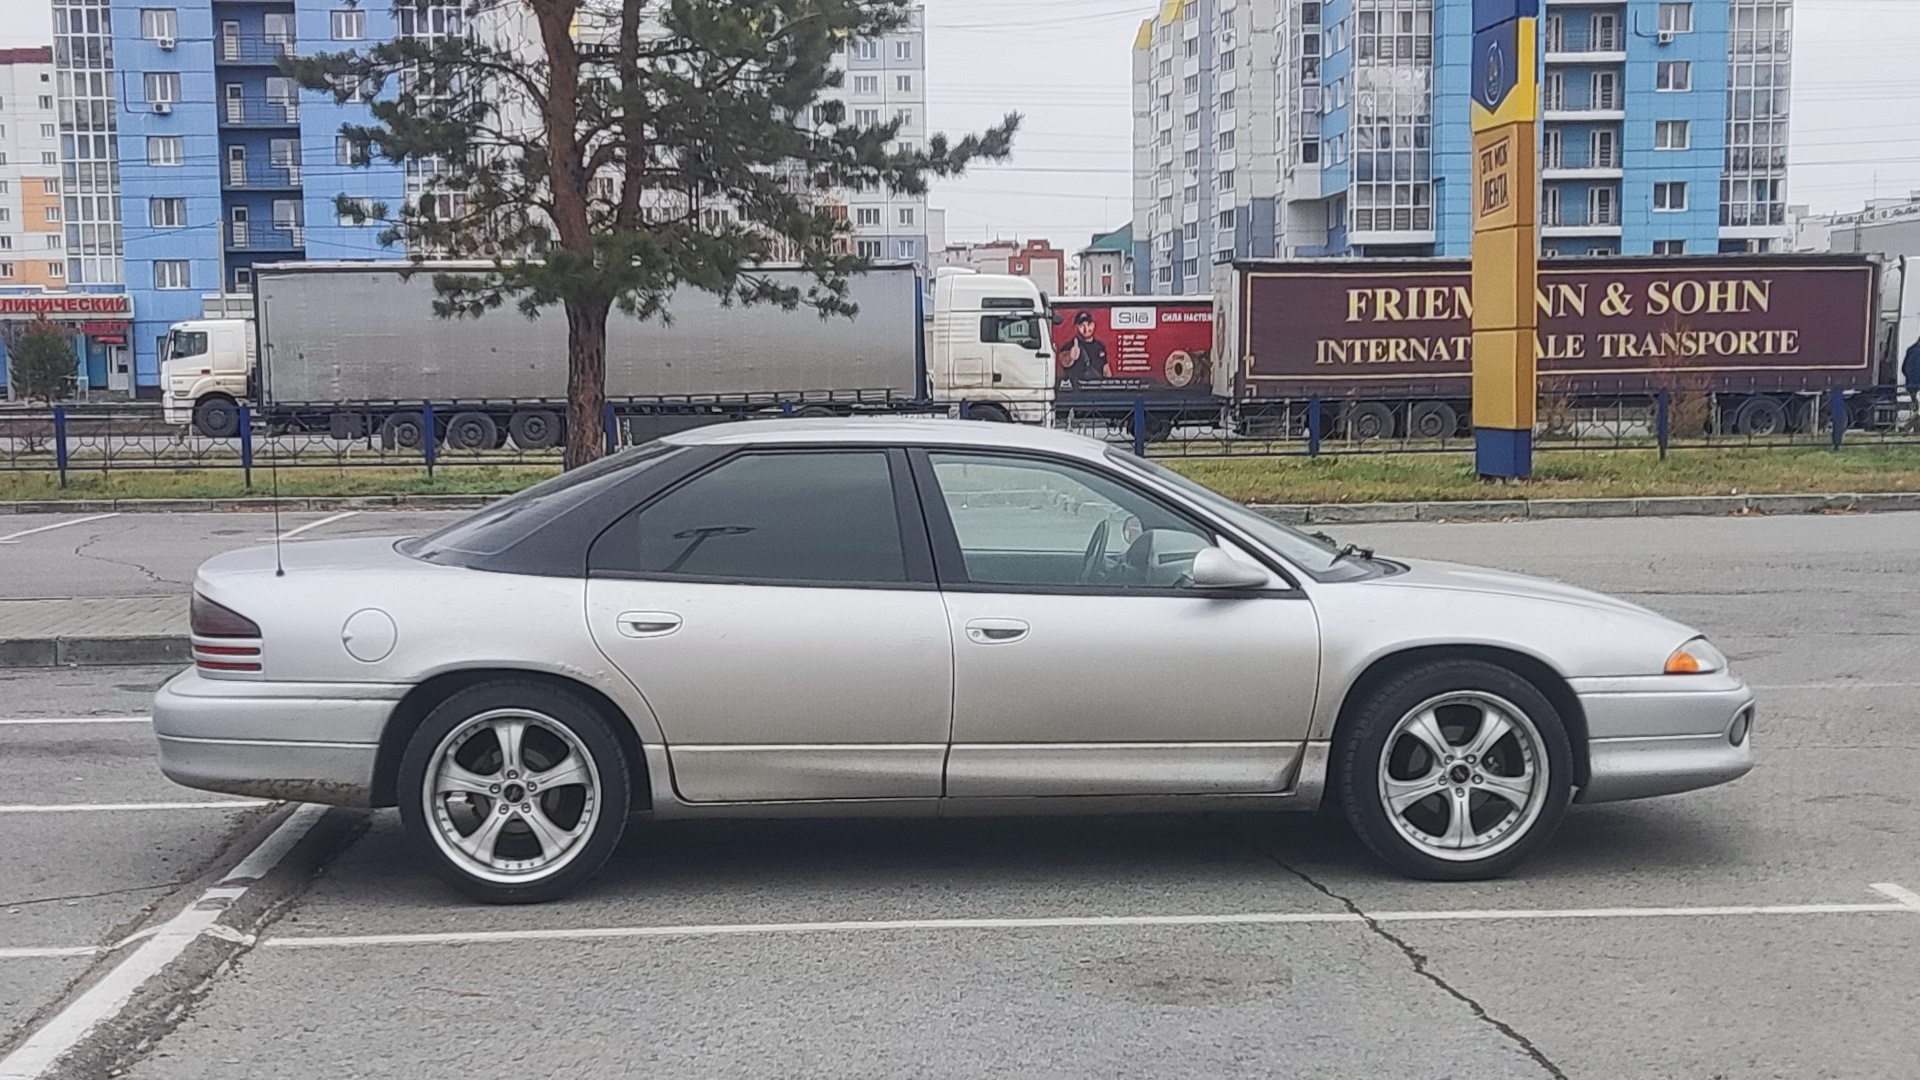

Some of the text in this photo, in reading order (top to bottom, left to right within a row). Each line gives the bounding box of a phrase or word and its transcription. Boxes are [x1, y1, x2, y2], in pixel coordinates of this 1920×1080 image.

[1344, 279, 1773, 322] FRIEMNN & SOHN
[1597, 329, 1801, 361] TRANSPORTE
